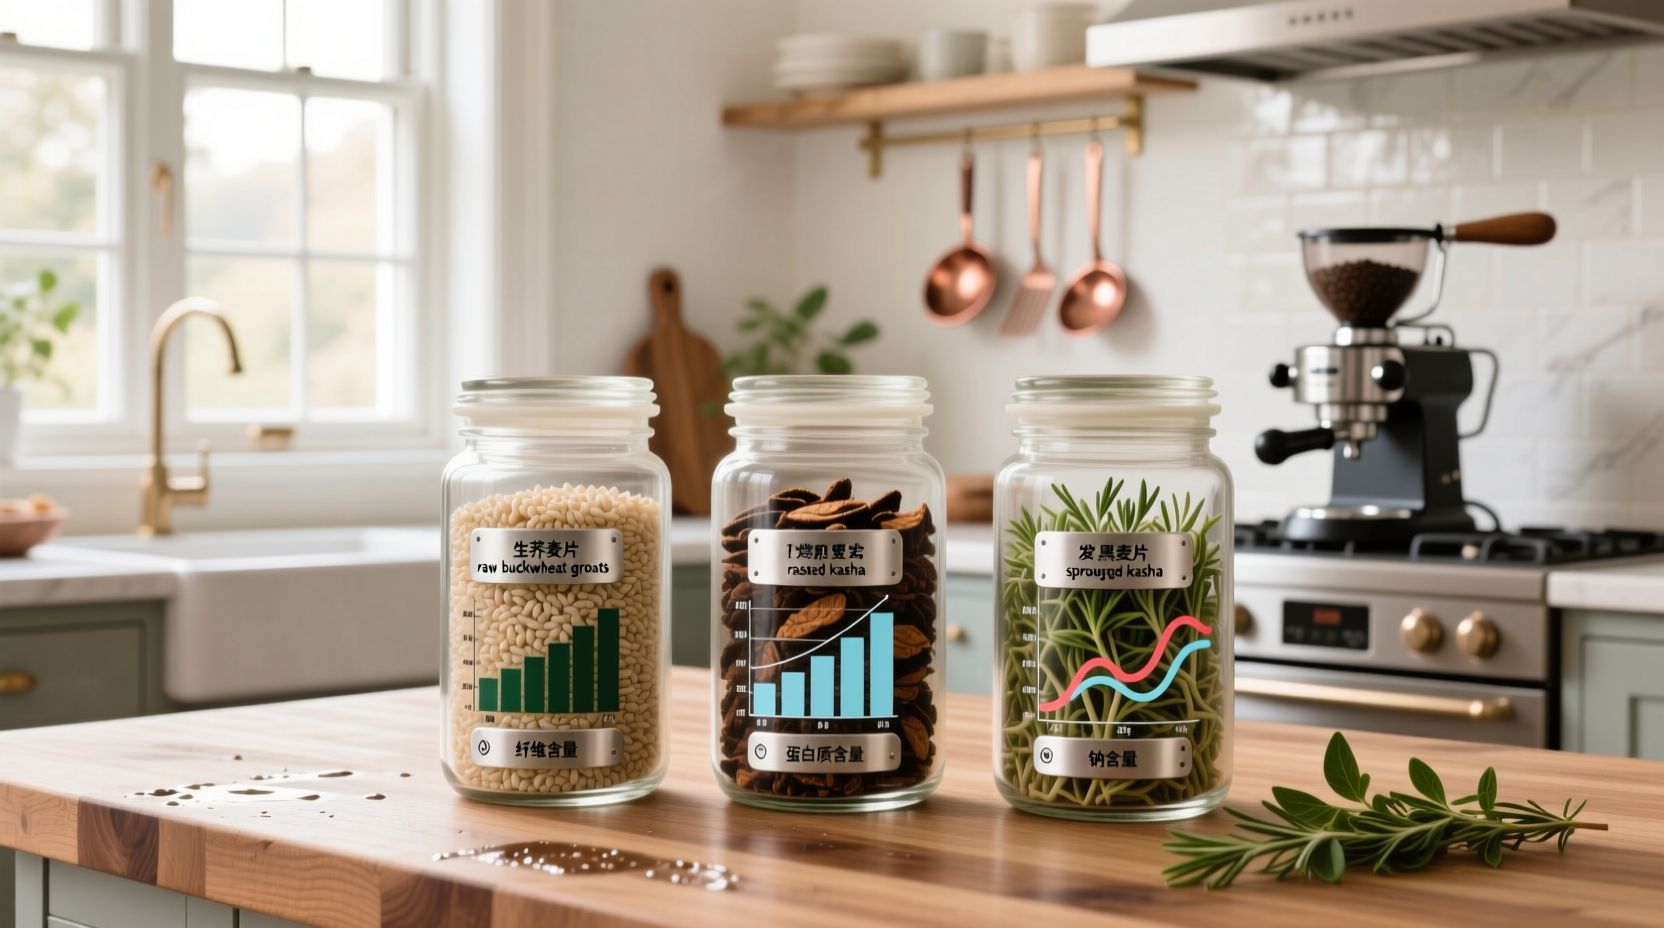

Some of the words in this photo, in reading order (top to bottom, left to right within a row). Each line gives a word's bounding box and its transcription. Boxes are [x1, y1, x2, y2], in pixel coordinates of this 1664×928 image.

[477, 563, 497, 574] raw
[502, 560, 567, 574] buckwheat
[571, 562, 609, 577] groats
[829, 561, 866, 576] kasha
[1127, 563, 1163, 578] kasha
[515, 740, 578, 759] 纤维含量
[786, 744, 864, 763] 蛋白质含量
[1089, 750, 1137, 768] 钠含量
